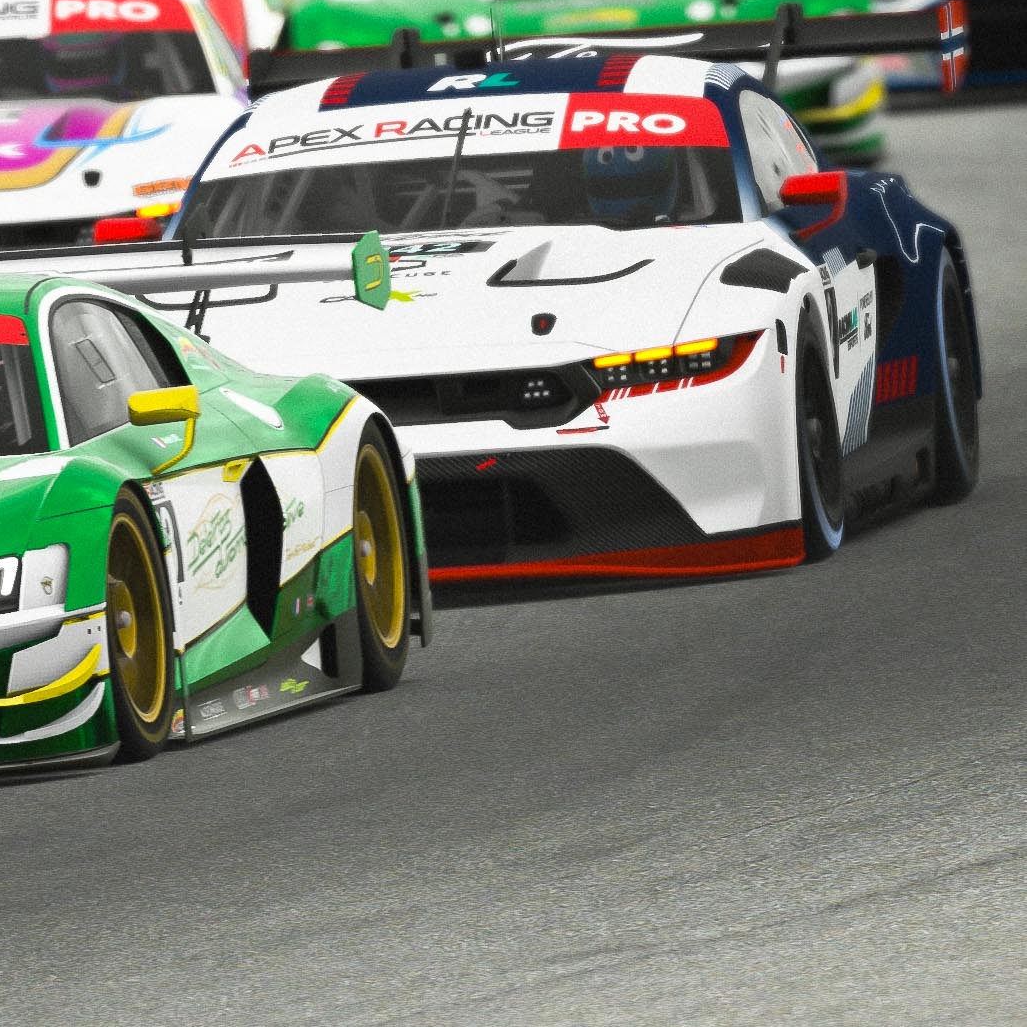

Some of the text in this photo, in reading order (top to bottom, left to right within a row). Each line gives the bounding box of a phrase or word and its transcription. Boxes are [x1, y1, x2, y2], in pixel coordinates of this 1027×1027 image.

[427, 73, 521, 92] RL
[480, 127, 552, 137] LEAGUE
[571, 110, 686, 134] PRO
[231, 111, 555, 159] APEX RACING
